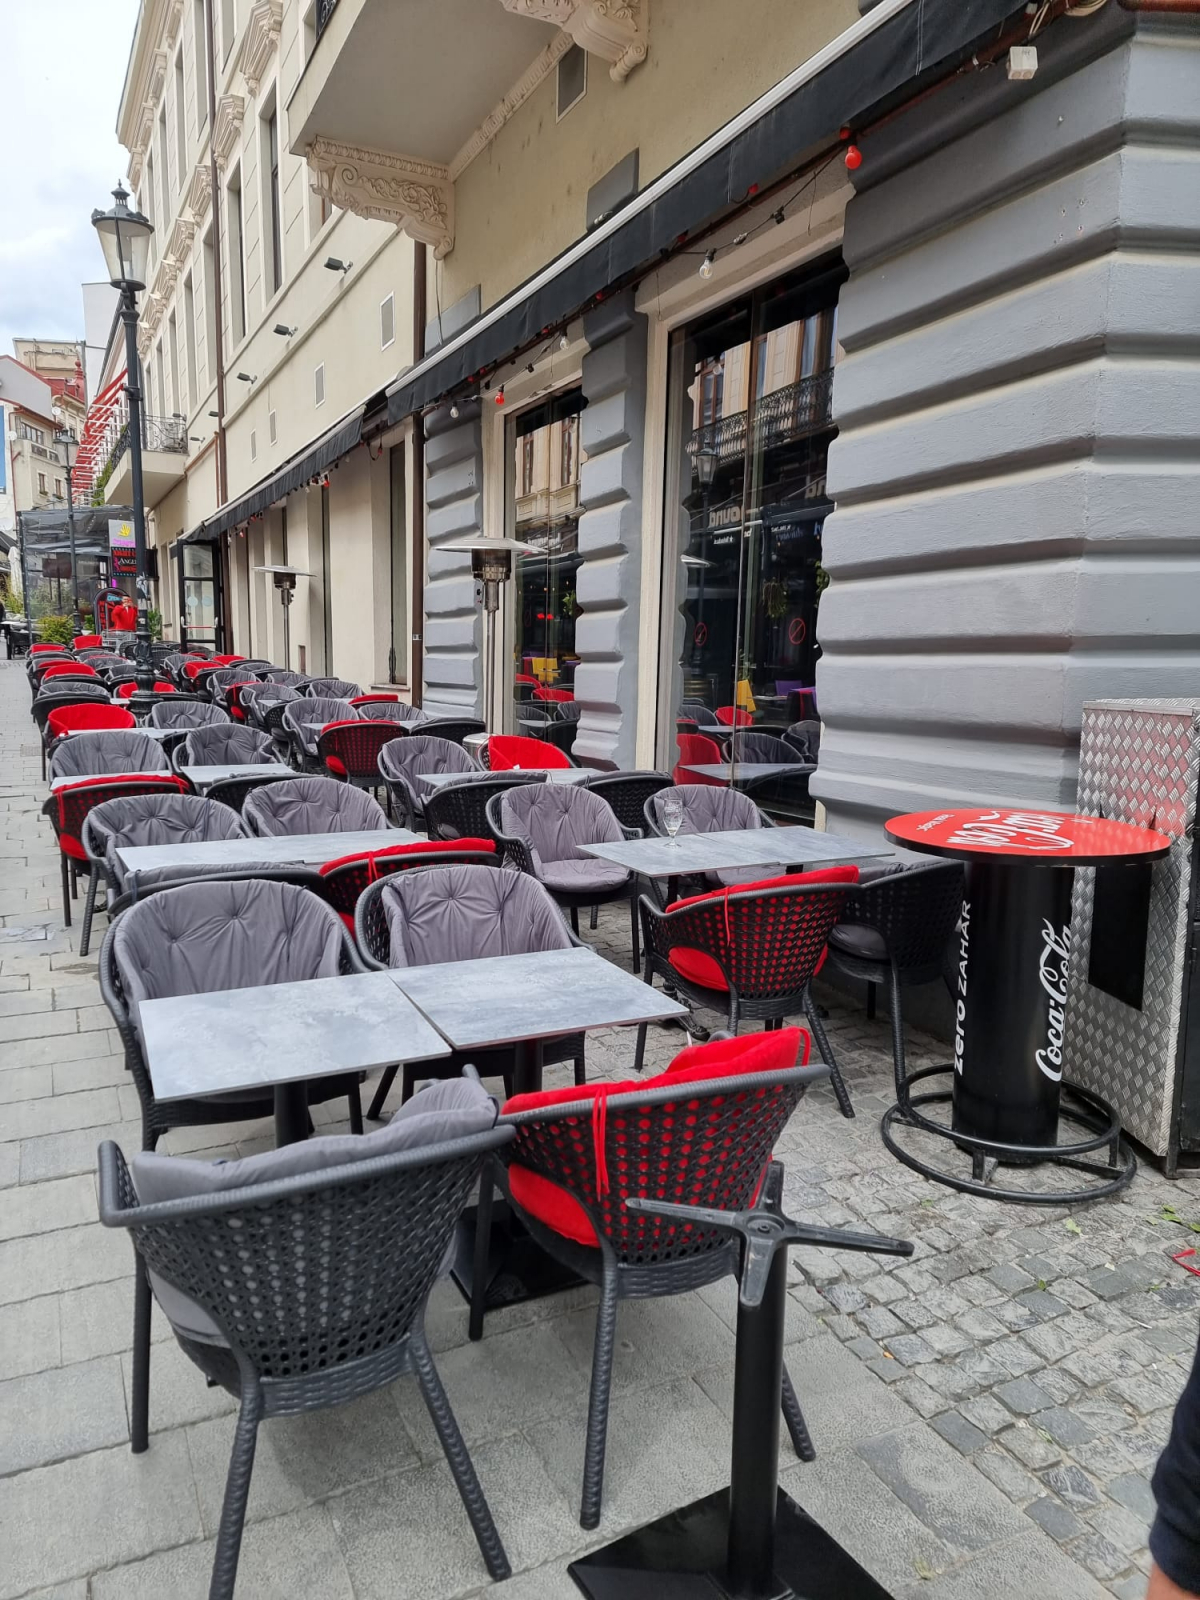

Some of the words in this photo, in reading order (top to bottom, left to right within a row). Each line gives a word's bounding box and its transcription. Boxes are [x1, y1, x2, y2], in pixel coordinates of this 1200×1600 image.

[957, 900, 971, 997] ZAHAR
[954, 999, 966, 1076] zero
[1035, 918, 1072, 1082] Coca-Cola
